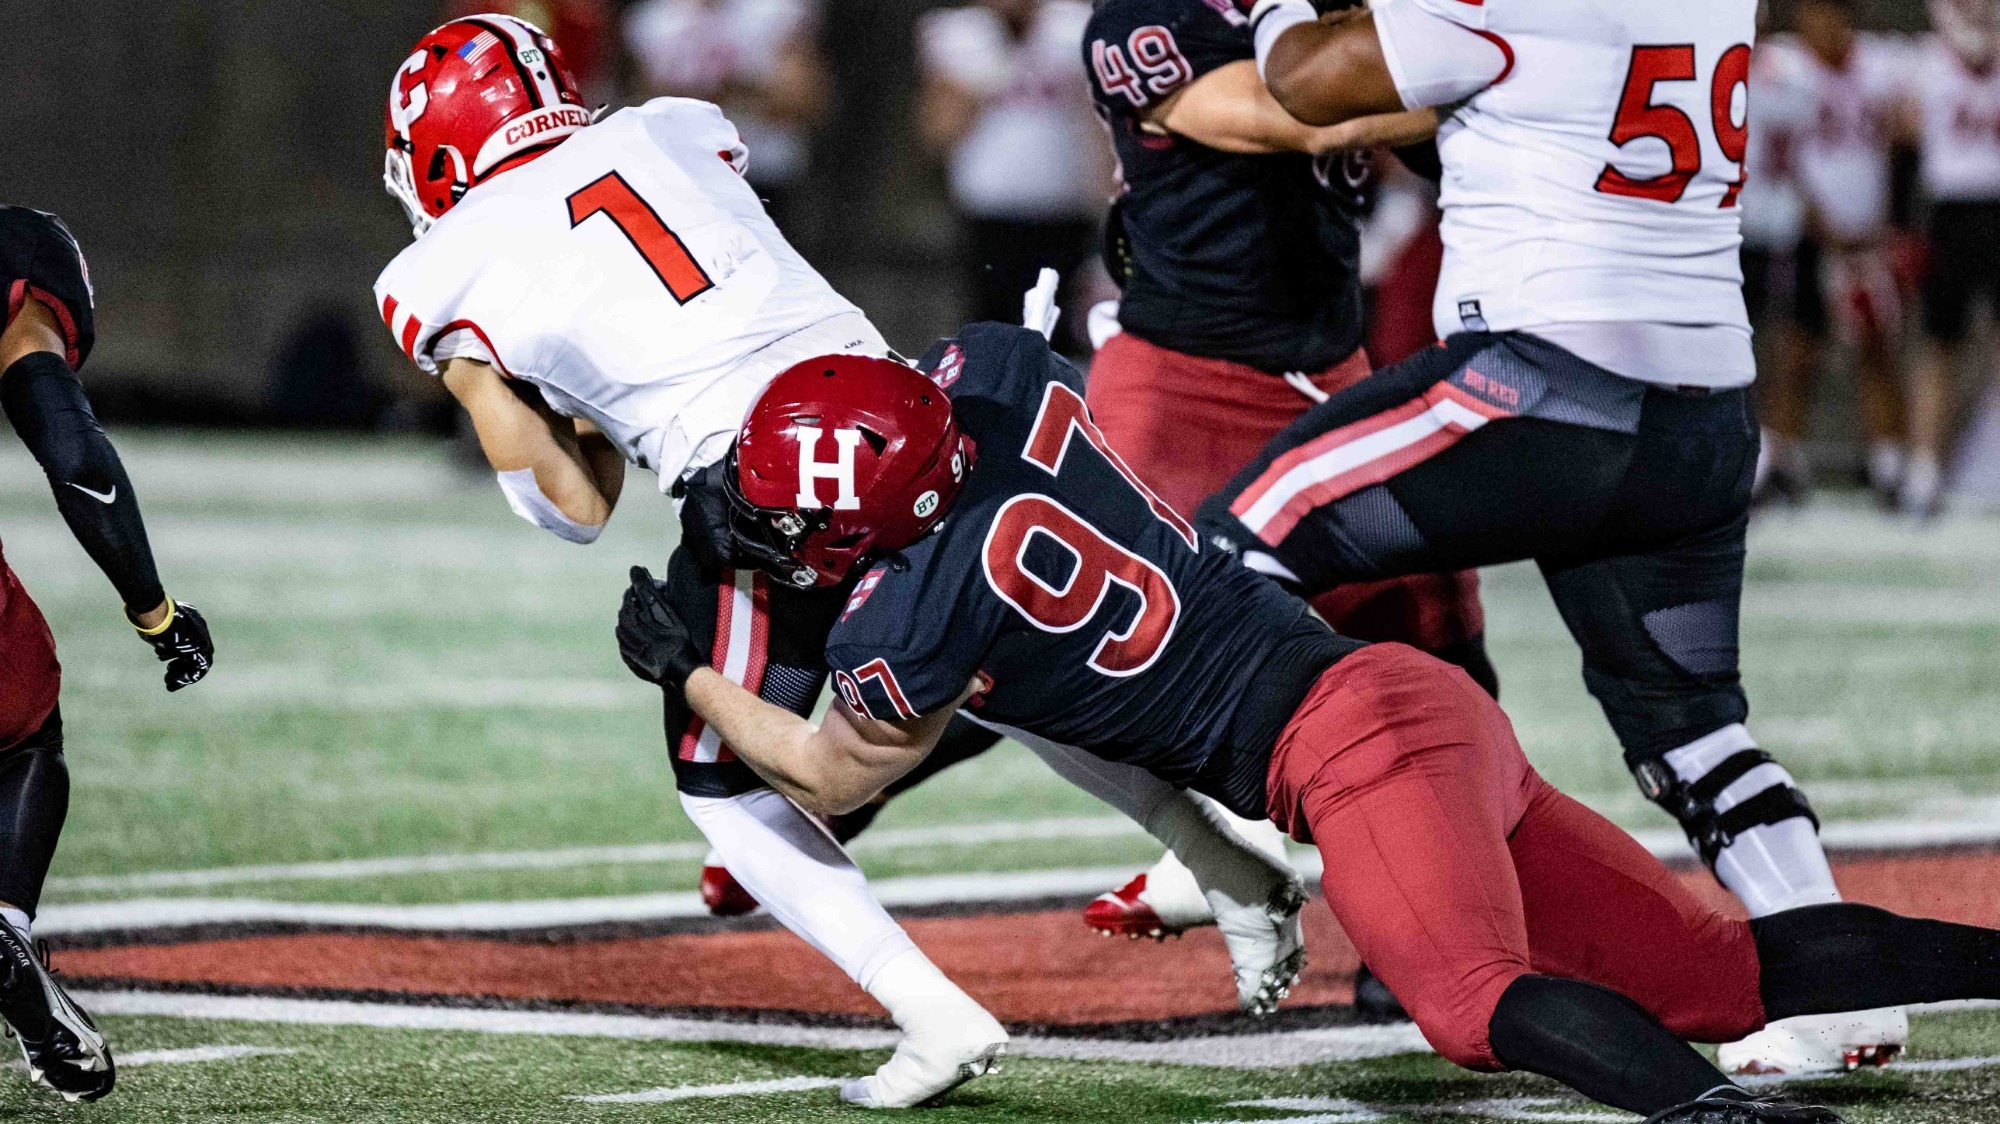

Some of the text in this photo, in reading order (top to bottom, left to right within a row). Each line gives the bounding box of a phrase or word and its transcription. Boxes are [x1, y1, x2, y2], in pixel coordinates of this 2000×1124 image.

[389, 48, 429, 131] C
[520, 49, 541, 64] BT
[1092, 25, 1193, 107] 49
[1593, 43, 1752, 208] 59
[565, 169, 715, 306] 1
[796, 426, 861, 510] H
[916, 493, 936, 515] BT
[982, 380, 1199, 678] 97
[836, 657, 922, 721] 97
